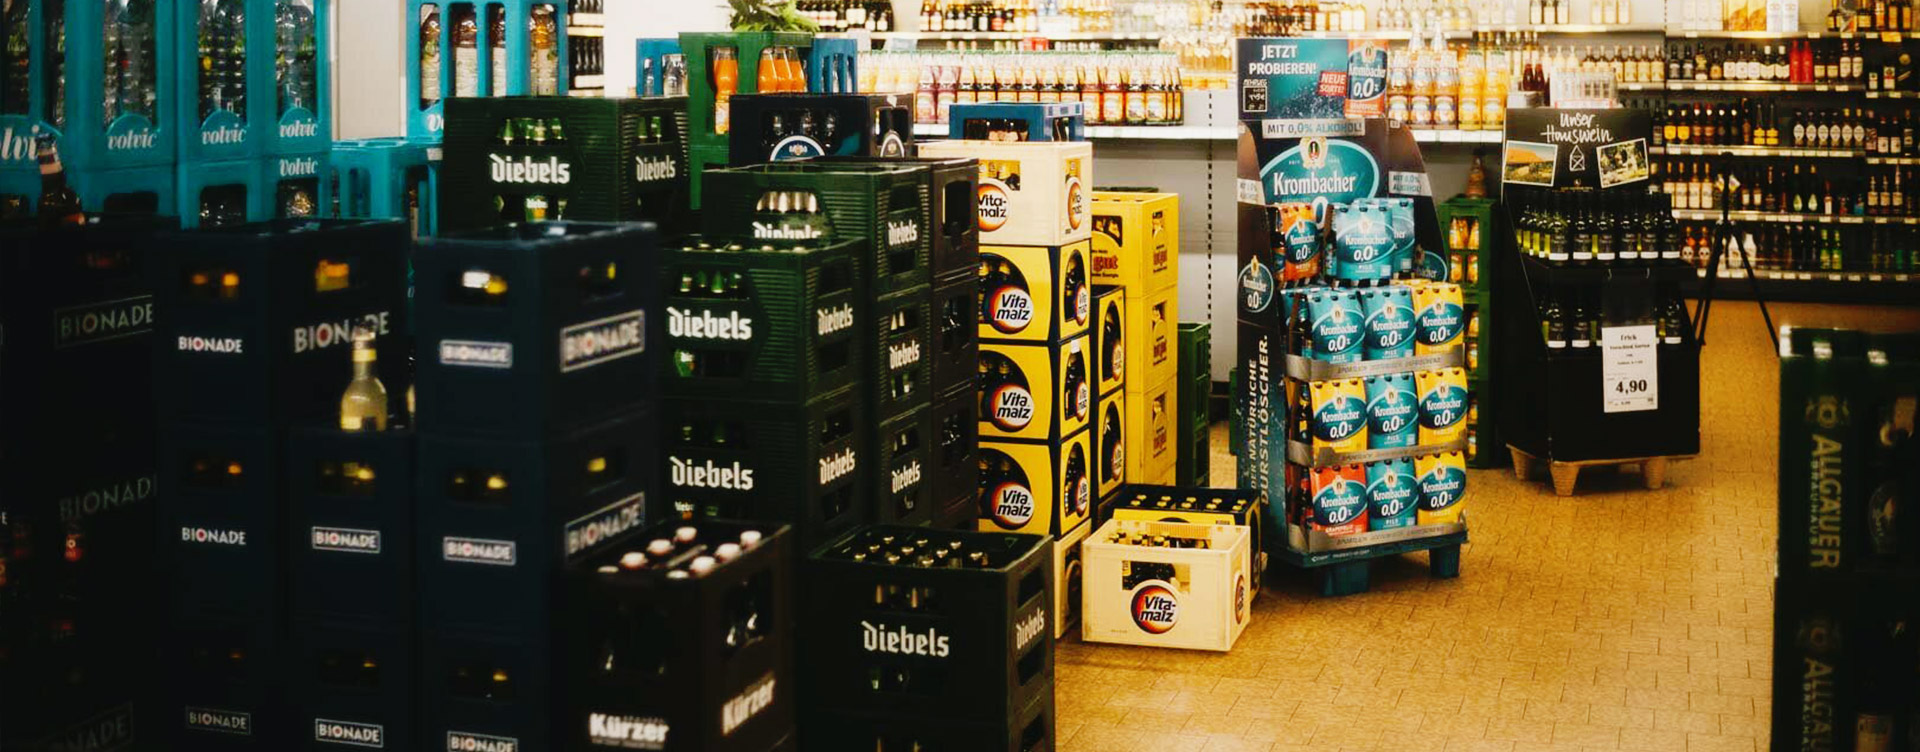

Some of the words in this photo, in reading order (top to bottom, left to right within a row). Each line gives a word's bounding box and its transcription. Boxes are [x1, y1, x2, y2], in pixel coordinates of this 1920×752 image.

[1261, 45, 1298, 60] JETZT
[1249, 62, 1317, 75] PROBIEREN!
[1321, 73, 1346, 84] NEUE
[1267, 124, 1285, 134] MIT
[1288, 122, 1314, 135] 0,0%
[1316, 122, 1362, 133] ALKOHOL!
[1560, 112, 1595, 128] Unser
[1540, 124, 1614, 144] Hauswein
[489, 153, 570, 184] Diebels
[635, 155, 676, 182] Diebels
[1273, 170, 1356, 196] Krombacher
[887, 219, 918, 246] Diebels
[1001, 293, 1028, 308] Vita
[60, 304, 153, 339] BIONADE
[666, 306, 752, 340] Diebels
[817, 302, 853, 336] Diebels
[996, 308, 1030, 320] malz
[177, 335, 243, 354] BIONADE
[889, 339, 920, 370] Diebels
[1615, 379, 1648, 395] 4,90
[1002, 392, 1028, 406] Vita
[996, 406, 1030, 419] malz
[1258, 334, 1269, 505] DURSTLÖSCHER.
[1321, 410, 1360, 423] Krombacher
[669, 455, 754, 491] Diebels
[819, 447, 855, 485] Diebels
[891, 460, 921, 494] Diebels
[1002, 489, 1028, 504] Vita
[1320, 494, 1360, 508] Krombacher
[1373, 488, 1411, 501] Krombacher
[996, 503, 1031, 517] malz
[181, 526, 247, 546] BIONADE
[567, 503, 640, 554] BIONADE
[314, 531, 377, 549] BIONADE
[446, 541, 512, 560] BIONADE
[1144, 595, 1176, 610] Vita-
[1139, 609, 1175, 622] malz
[1015, 606, 1045, 650] Diebels
[861, 620, 949, 658] Diebels
[188, 711, 248, 730] BIONADE
[318, 723, 381, 744] BIONADE
[451, 735, 515, 752] BIONADE
